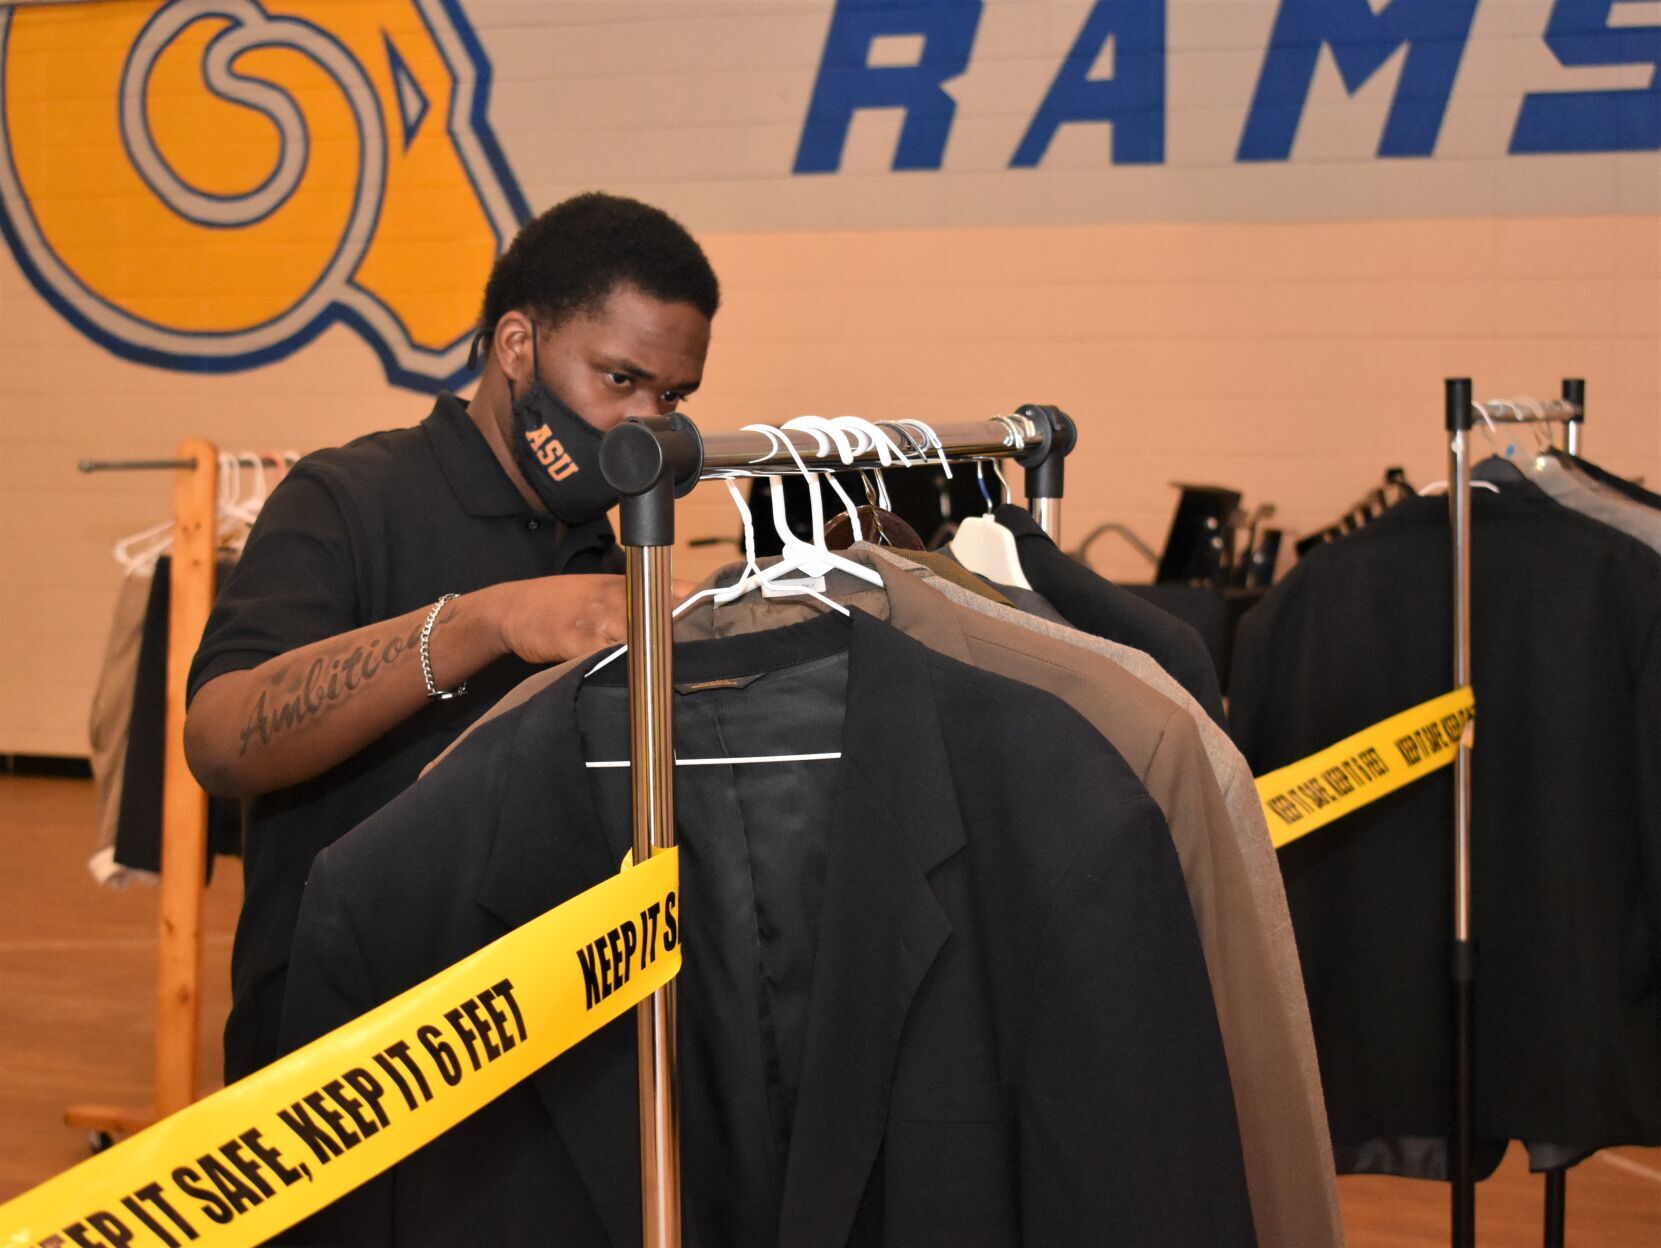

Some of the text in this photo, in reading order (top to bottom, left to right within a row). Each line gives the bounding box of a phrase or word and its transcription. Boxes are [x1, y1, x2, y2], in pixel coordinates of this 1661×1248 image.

[792, 0, 1661, 175] RAMS
[525, 423, 579, 481] ASU
[575, 891, 681, 1012] KEEP IT S
[120, 1181, 200, 1248] IT
[276, 1067, 391, 1165] KEEP
[371, 1039, 434, 1112] IT
[416, 1024, 463, 1087] 6
[442, 977, 528, 1072] FEET
